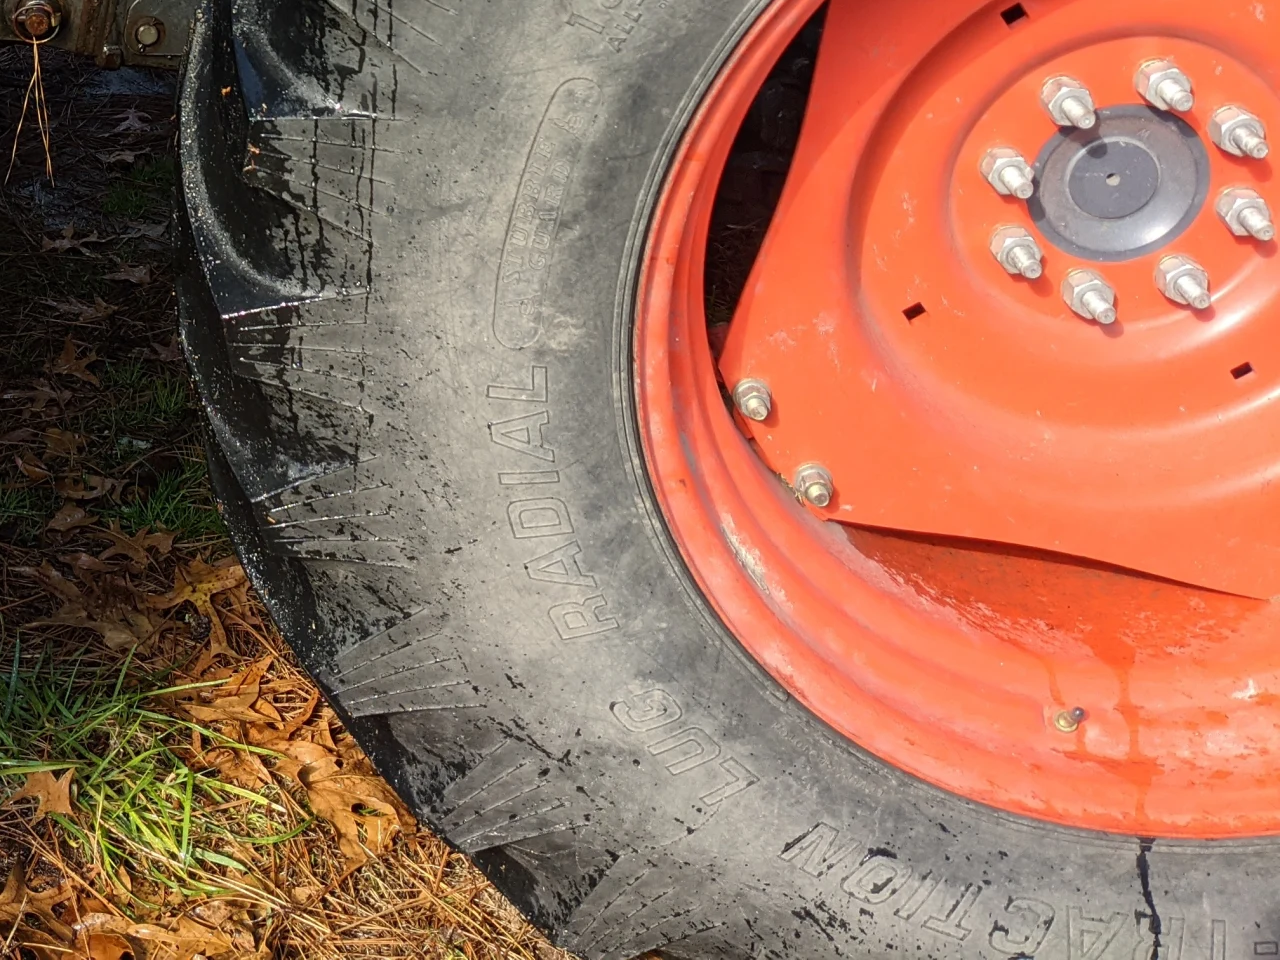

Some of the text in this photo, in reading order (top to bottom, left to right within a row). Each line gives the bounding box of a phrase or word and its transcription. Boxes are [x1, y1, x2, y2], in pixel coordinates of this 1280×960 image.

[502, 136, 556, 285] STUBBLE
[528, 158, 571, 272] GUARD
[486, 365, 620, 640] RADIAL
[609, 688, 761, 807] LUG
